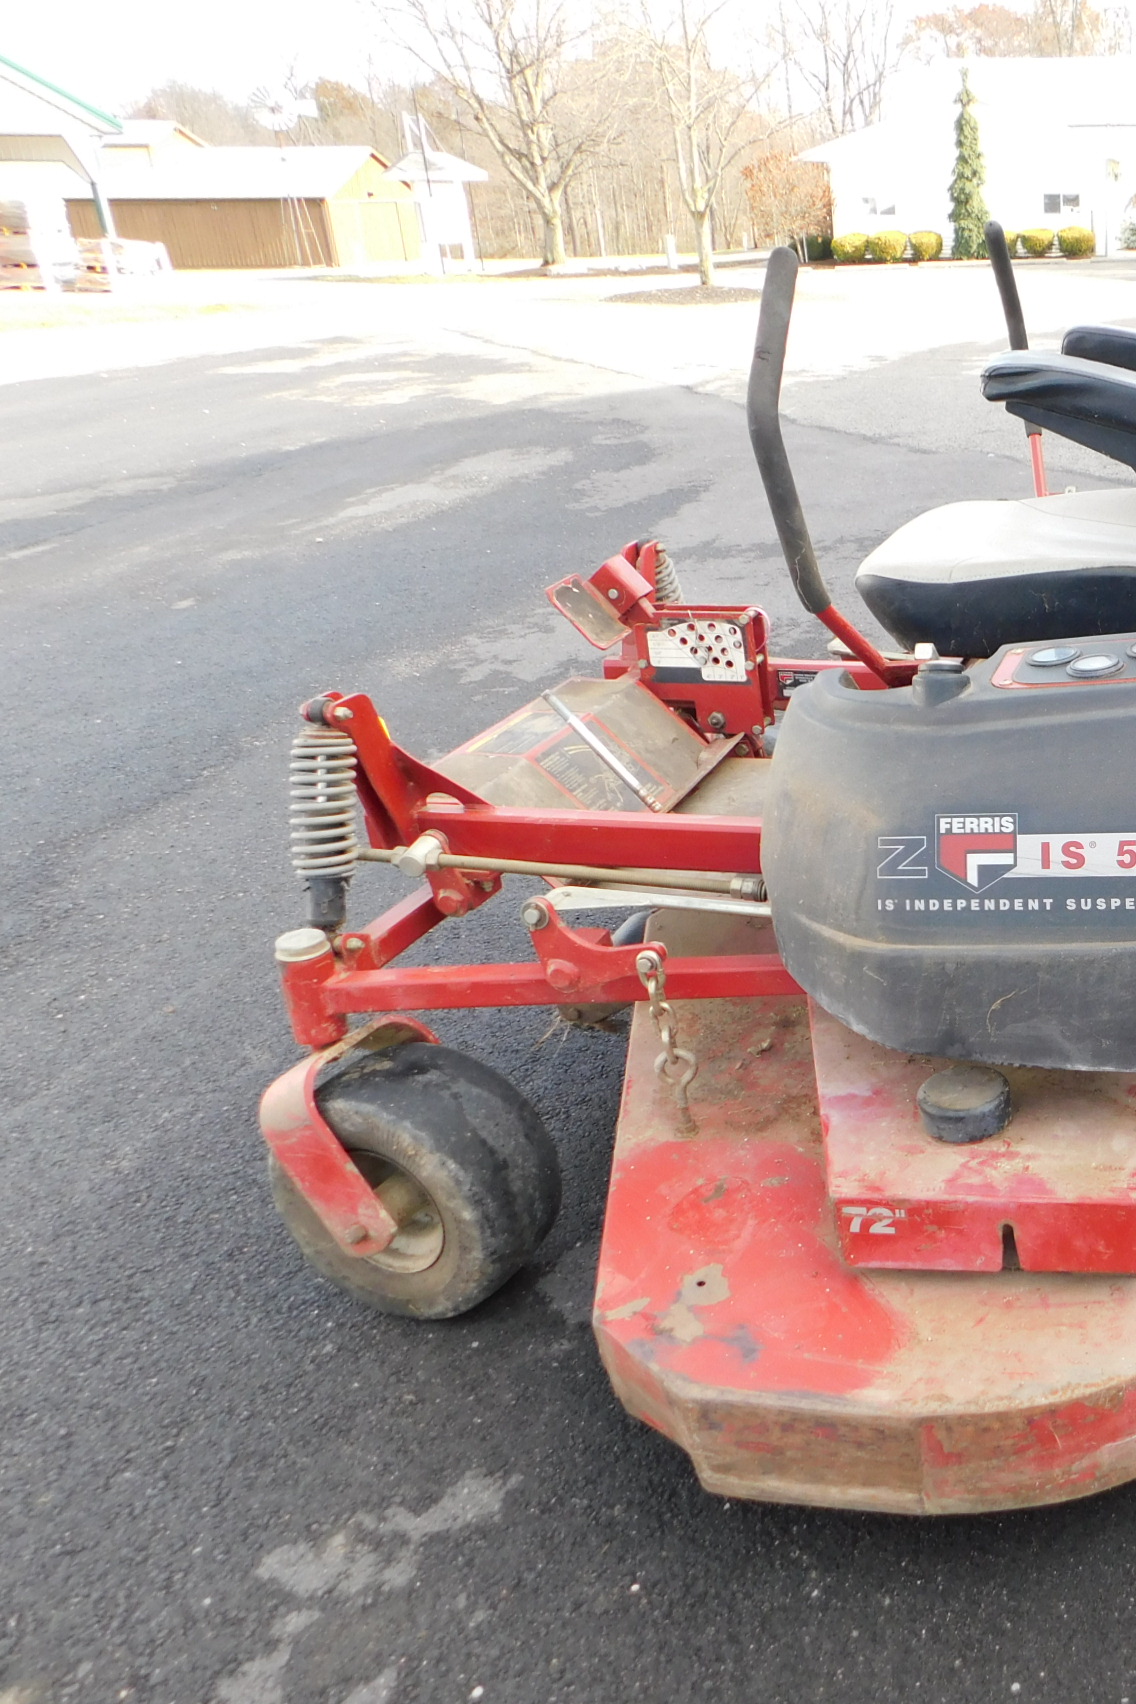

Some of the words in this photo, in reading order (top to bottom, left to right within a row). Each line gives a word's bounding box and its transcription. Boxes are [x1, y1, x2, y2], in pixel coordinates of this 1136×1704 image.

[939, 816, 1015, 834] FERRIS
[877, 836, 928, 878] Z
[905, 898, 1053, 911] INDEPENDENT
